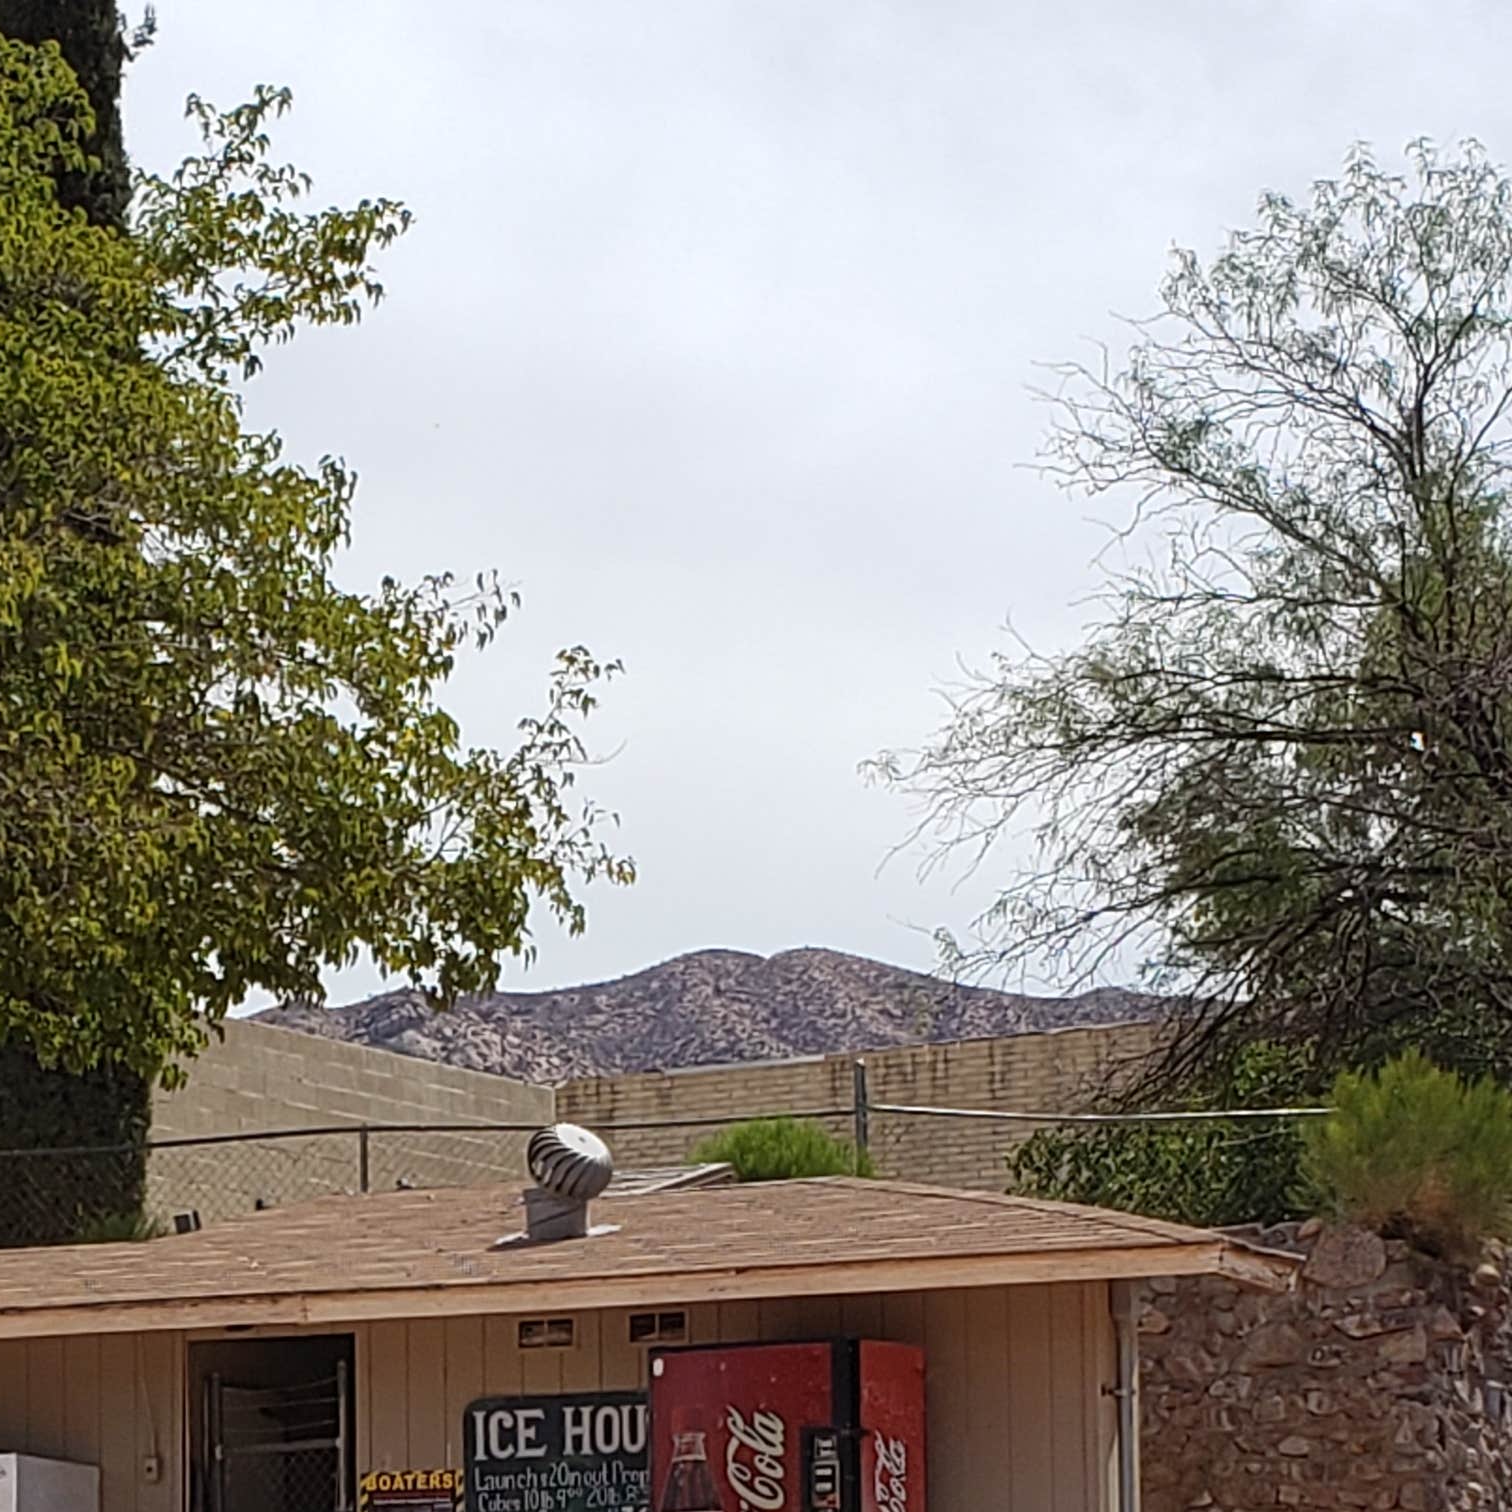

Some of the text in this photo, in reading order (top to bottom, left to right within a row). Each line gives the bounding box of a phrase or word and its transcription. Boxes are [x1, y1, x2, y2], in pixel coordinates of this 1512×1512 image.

[472, 1404, 650, 1461] ICE HOU
[366, 1472, 454, 1491] BOATERS
[474, 1466, 537, 1491] Launch
[478, 1491, 521, 1512] Cubes
